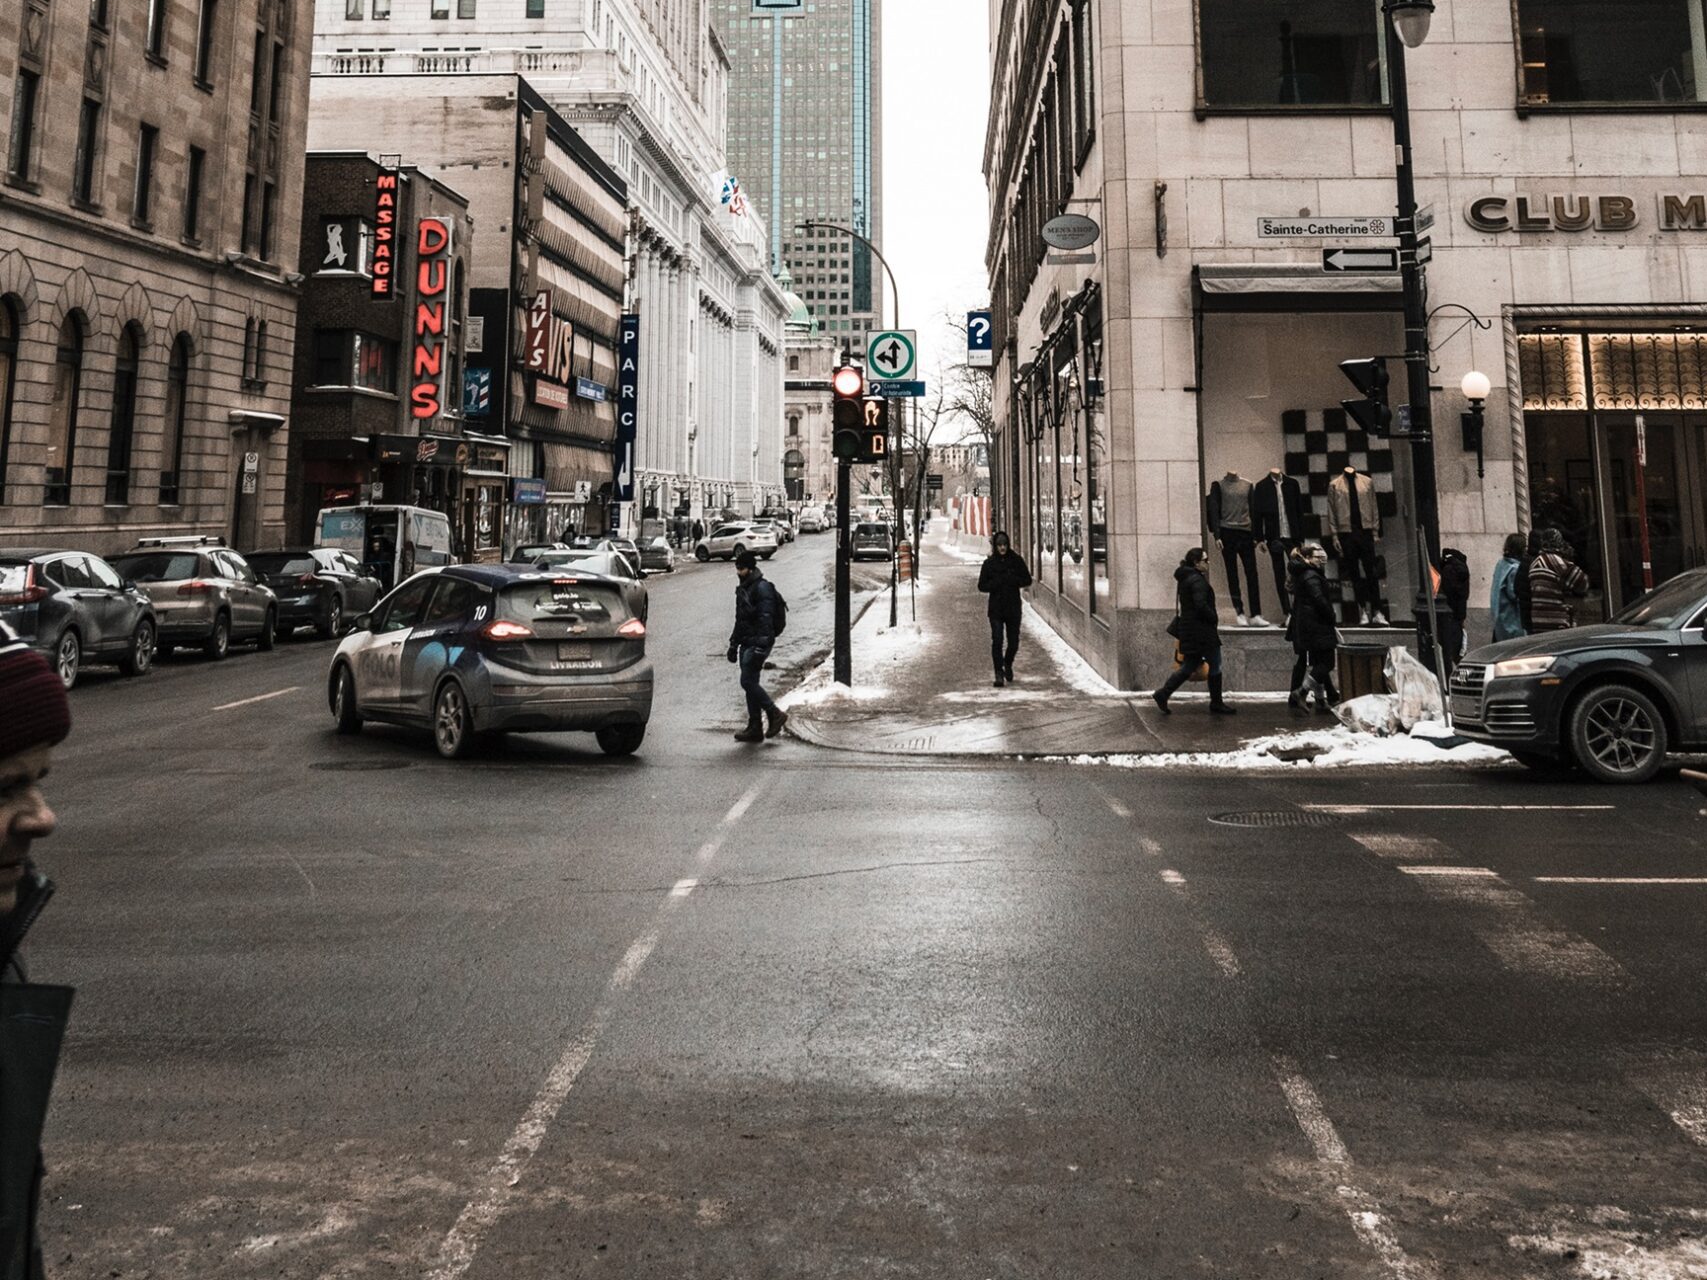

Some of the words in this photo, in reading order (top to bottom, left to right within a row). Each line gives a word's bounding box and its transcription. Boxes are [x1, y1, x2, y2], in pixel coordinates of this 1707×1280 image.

[374, 175, 396, 293] MASSAGE
[1263, 223, 1369, 235] Sainte-Catherine
[1468, 195, 1638, 228] CLUB
[411, 218, 448, 418] DUNNS
[529, 292, 547, 367] AVIS
[621, 330, 636, 426] PARC
[473, 605, 487, 621] 10
[550, 661, 603, 670] LIVRAISON
